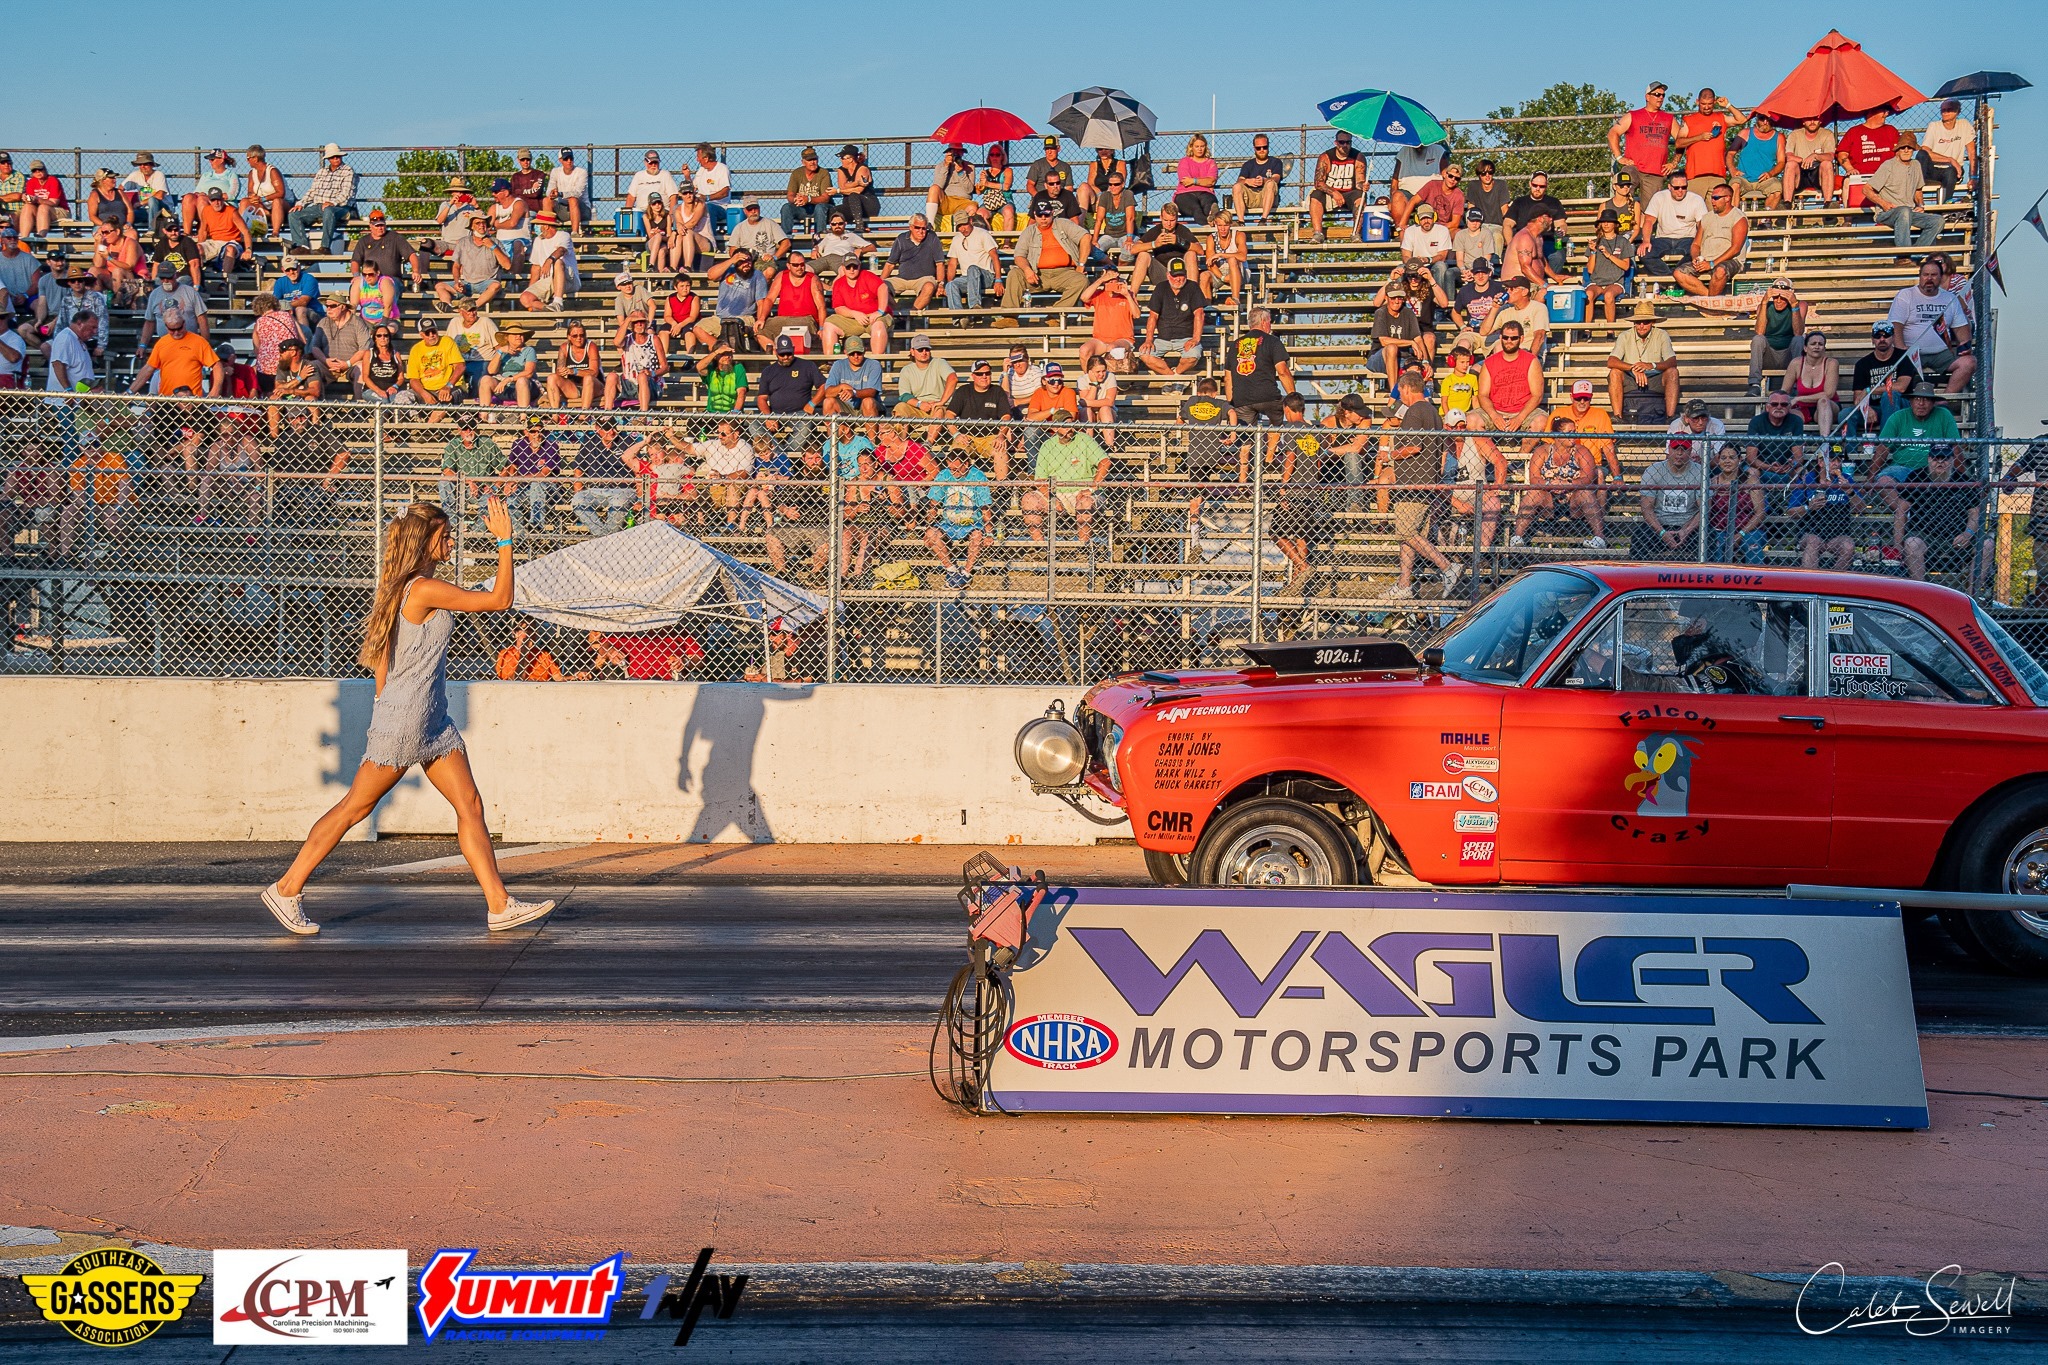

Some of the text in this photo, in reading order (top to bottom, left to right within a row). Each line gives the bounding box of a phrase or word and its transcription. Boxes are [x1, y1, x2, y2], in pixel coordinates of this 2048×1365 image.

[1329, 163, 1354, 178] DAD
[1657, 573, 1764, 585] MILLER BOYZ
[1829, 614, 1851, 626] WIX
[1958, 623, 2016, 688] THANKS MOM
[1832, 666, 1888, 675] RACING GEAR
[1830, 675, 1908, 697] Hoosier
[1191, 704, 1251, 716] TECHNOLOGY
[1619, 704, 1717, 731] Falcon
[1167, 732, 1212, 741] ENGINE BY
[1440, 733, 1490, 745] MAHLE
[1158, 742, 1221, 756] SAM JONES
[1154, 759, 1196, 767] CHASSIS BY
[1154, 768, 1181, 778] MARK
[1183, 768, 1205, 778] WILZ
[1154, 780, 1222, 789] CHUCK GARRETT
[1424, 784, 1460, 797] RAM
[1471, 781, 1494, 799] CPM
[1147, 810, 1193, 832] CMR
[1611, 814, 1709, 843] Crazy
[1143, 832, 1196, 842] Curt Miller Racing
[1462, 841, 1495, 852] SPEED
[1461, 850, 1493, 860] SPORT
[1065, 927, 1827, 1026] WAGLER
[1037, 1013, 1085, 1023] MEMBER
[1021, 1023, 1102, 1060] NHRA
[1128, 1027, 1827, 1081] MOTORSPORTS PARK
[1041, 1061, 1077, 1070] TRACK
